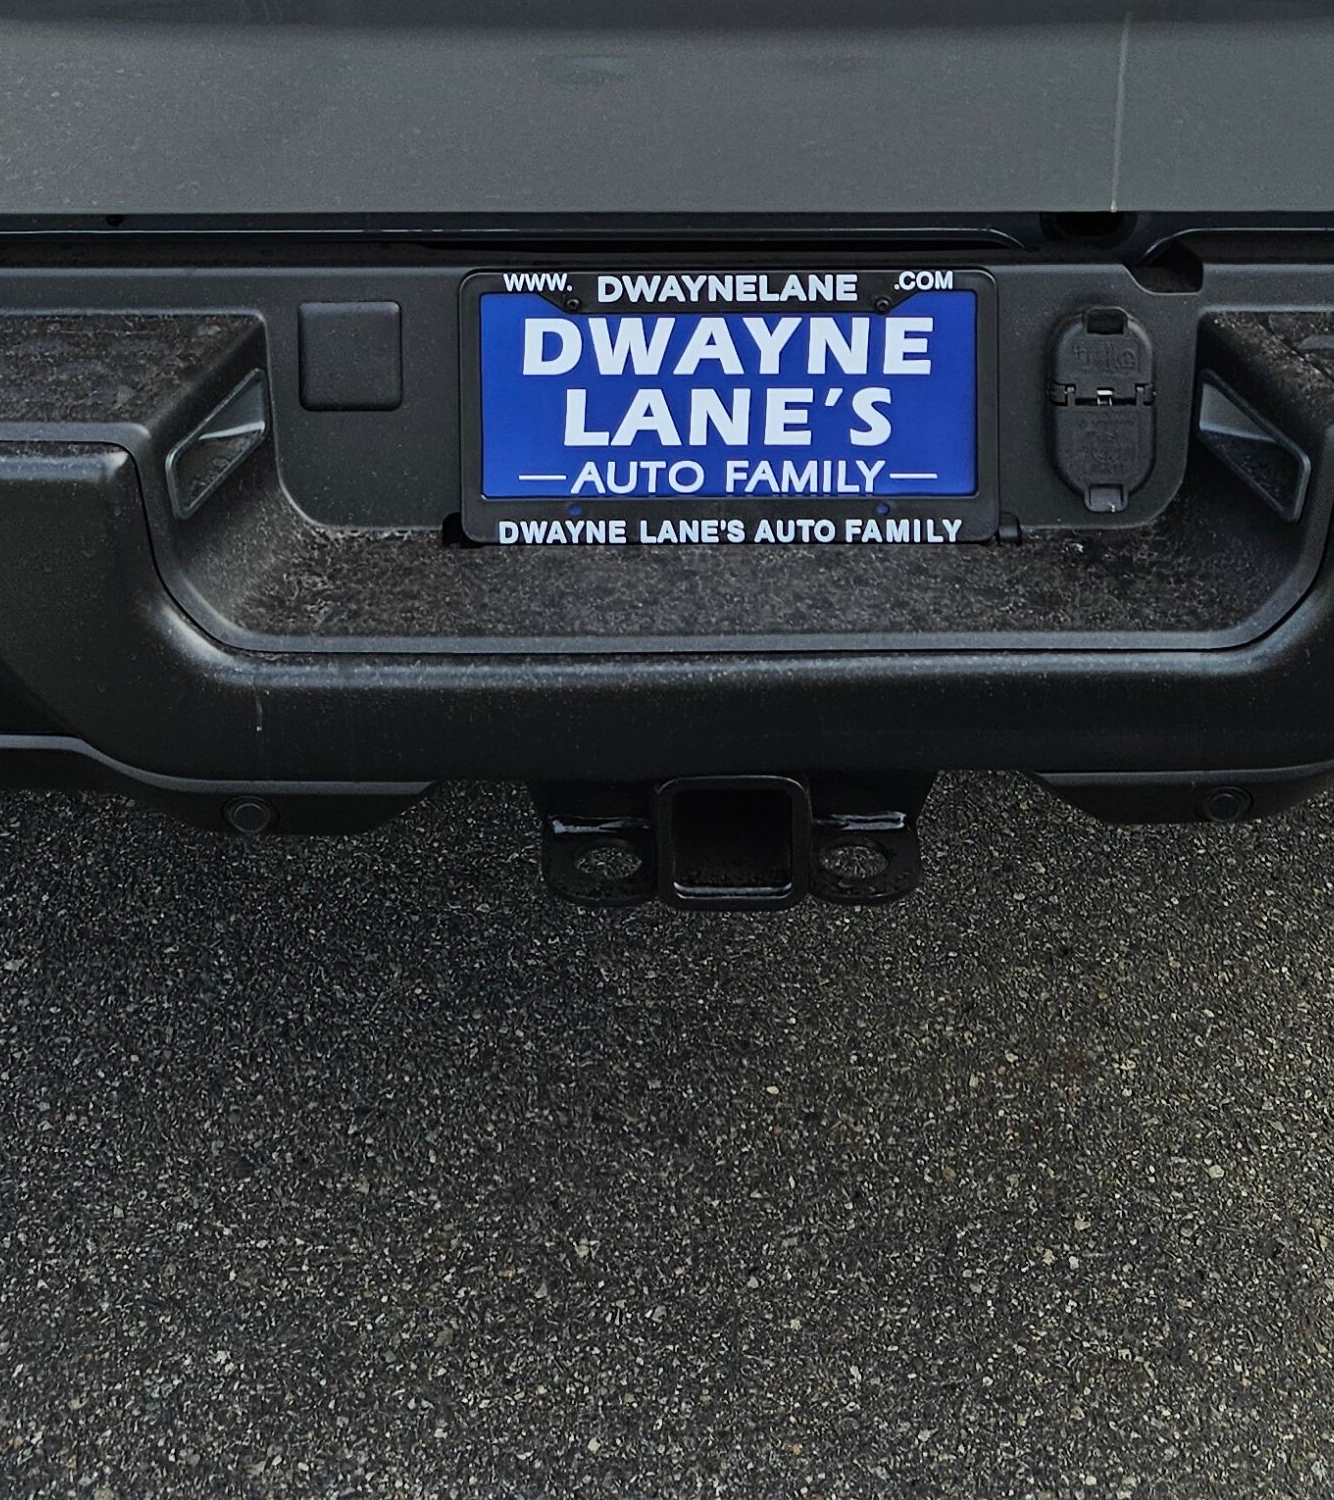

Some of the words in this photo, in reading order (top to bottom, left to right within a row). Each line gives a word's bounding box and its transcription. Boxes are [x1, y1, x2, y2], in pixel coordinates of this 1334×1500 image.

[503, 273, 572, 292] WWW.
[597, 274, 857, 302] DWAYNELANE
[893, 271, 953, 291] .COM
[523, 317, 934, 376] DWAYNE
[563, 386, 892, 446] LANE'S
[570, 460, 705, 494] AUTO
[726, 460, 885, 494] FAMILY
[498, 519, 626, 544] DWAYNE
[640, 519, 744, 543] LANE'S
[754, 519, 836, 543] AUTO
[845, 518, 962, 543] FAMILY
